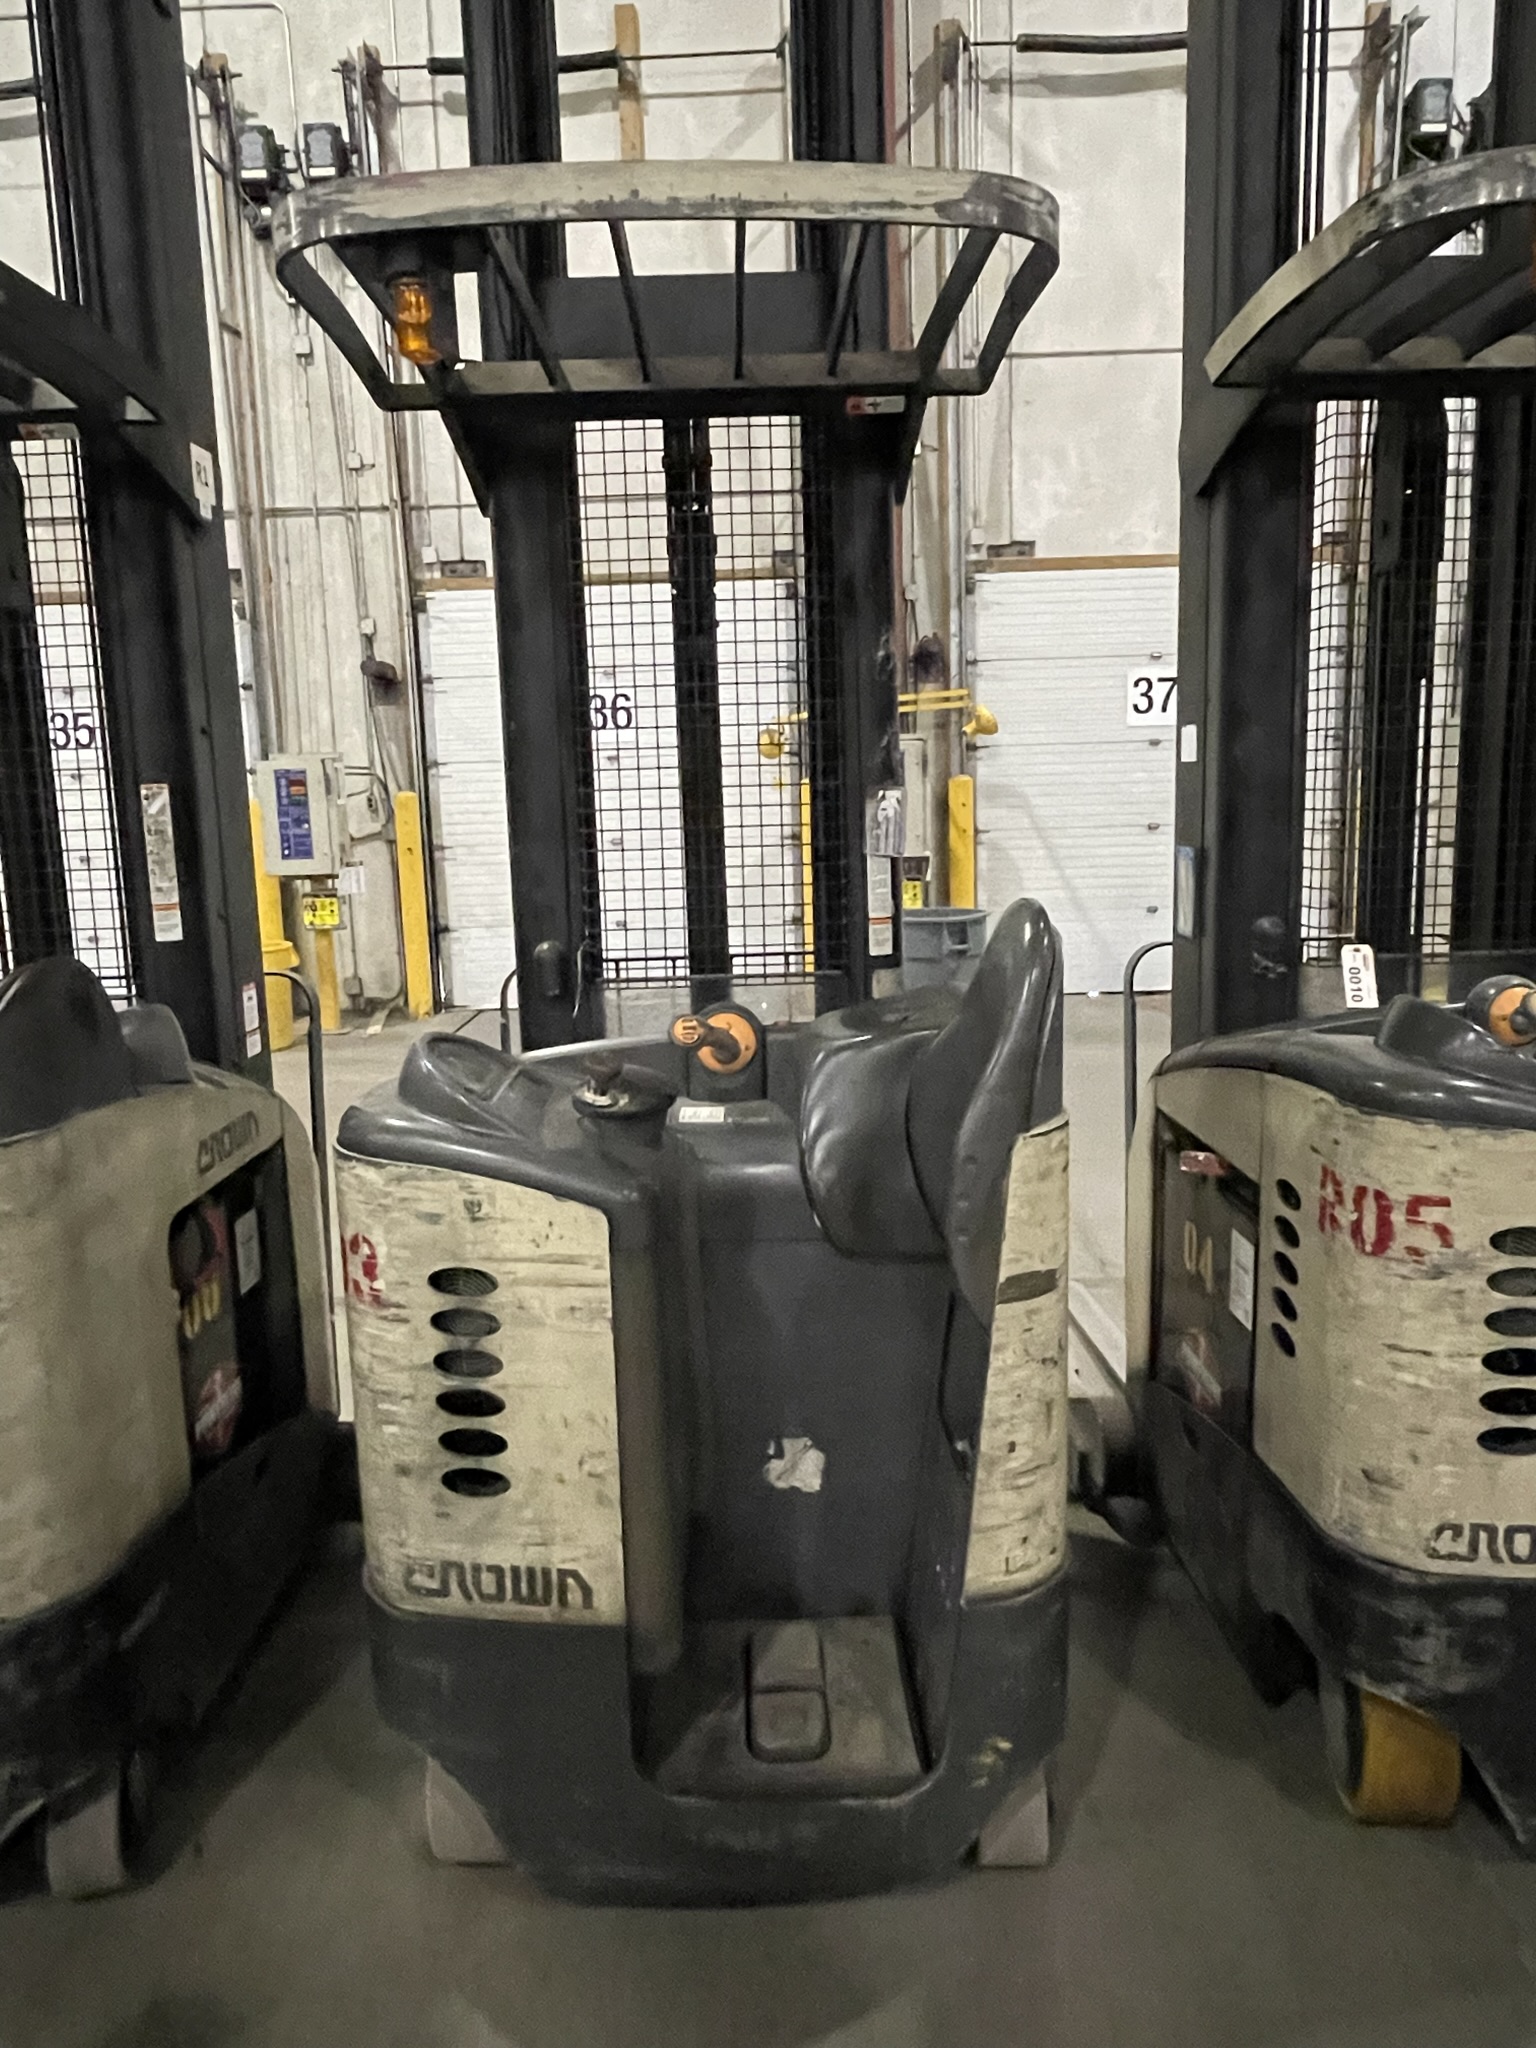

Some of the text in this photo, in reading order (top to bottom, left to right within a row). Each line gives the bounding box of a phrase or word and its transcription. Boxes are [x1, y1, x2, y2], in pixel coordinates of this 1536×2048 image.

[589, 693, 632, 730] 36
[1132, 677, 1178, 714] 37
[50, 712, 96, 750] 35
[1348, 966, 1364, 1003] 0010
[1318, 1163, 1454, 1266] R05
[402, 1559, 594, 1610] CROWN
